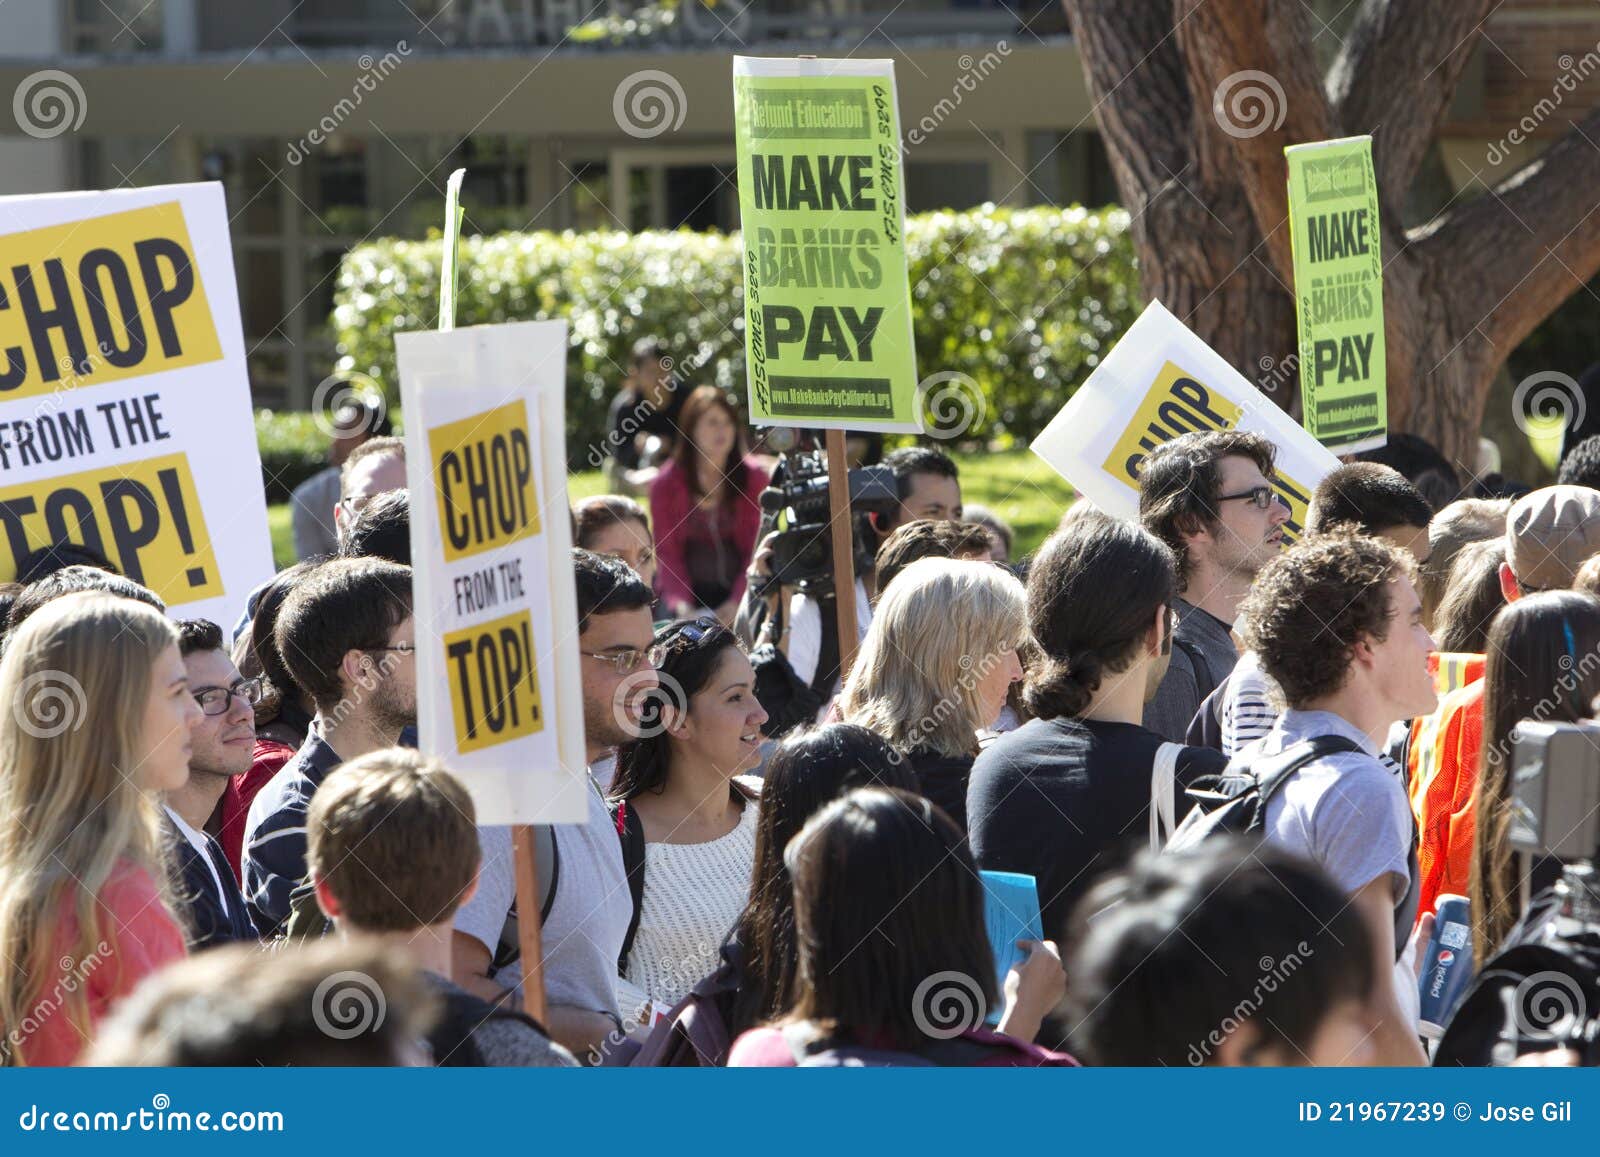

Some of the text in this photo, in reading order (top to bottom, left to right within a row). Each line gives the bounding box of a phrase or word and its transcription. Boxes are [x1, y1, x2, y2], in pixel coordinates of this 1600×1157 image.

[752, 98, 863, 128] Refund Education
[751, 154, 876, 212] MAKE
[758, 226, 882, 290] BANKS
[1307, 208, 1369, 263] MAKE
[1310, 269, 1373, 326] BANKS
[762, 304, 884, 362] PAY
[1314, 332, 1374, 387] PAY
[0, 393, 170, 470] FROM THE
[440, 427, 531, 551] CHOP
[454, 558, 525, 616] FROM THE
[448, 621, 539, 740] TOP!
